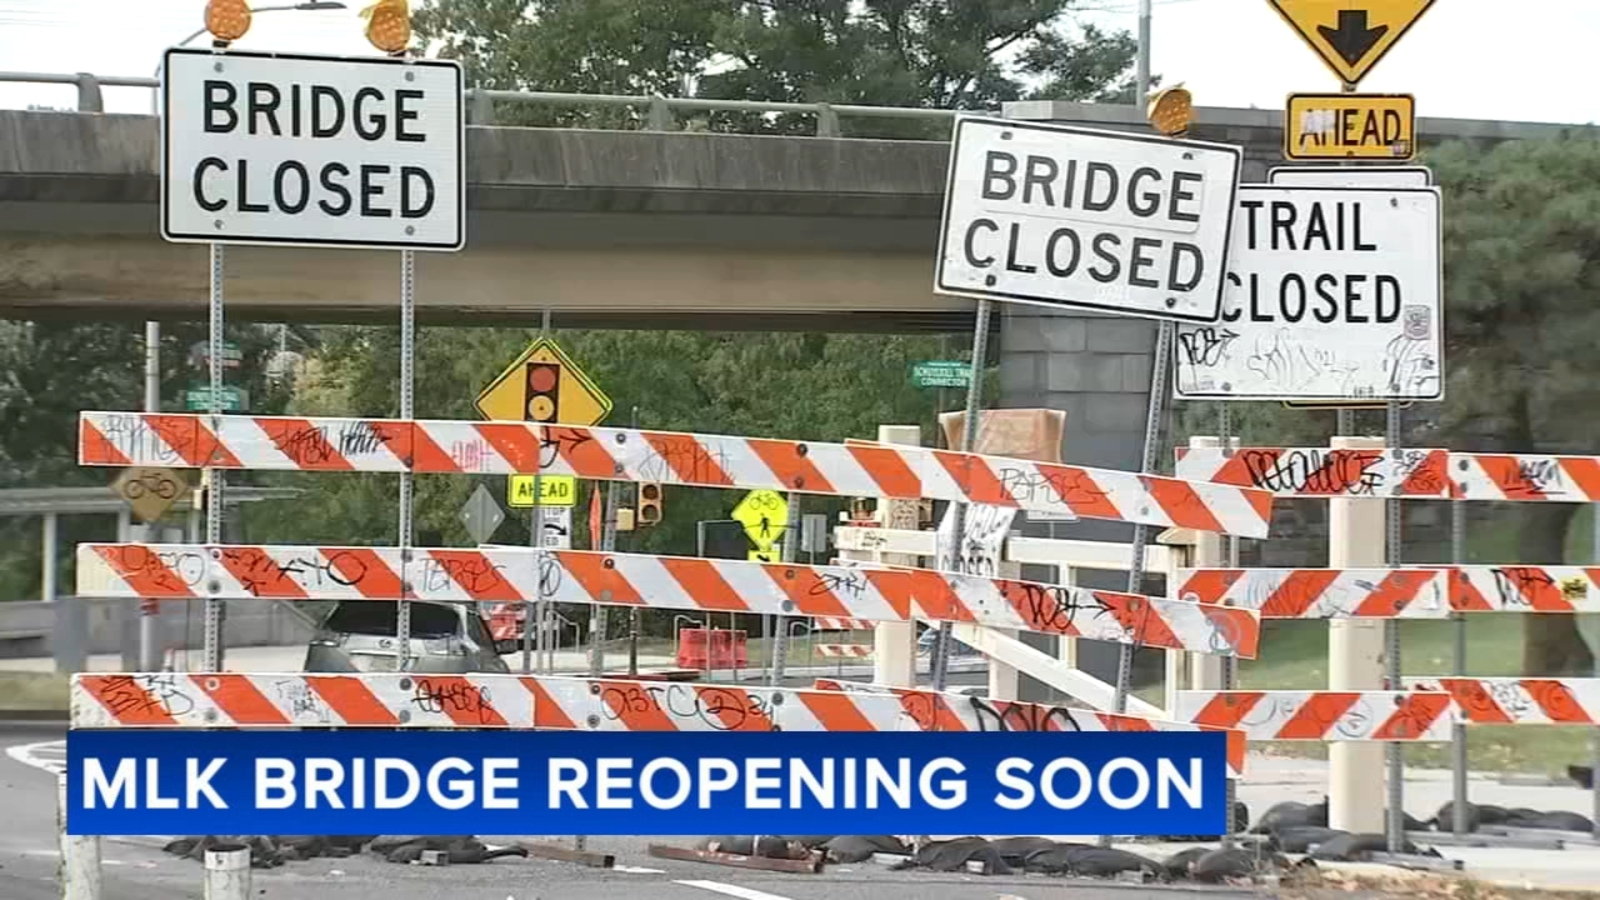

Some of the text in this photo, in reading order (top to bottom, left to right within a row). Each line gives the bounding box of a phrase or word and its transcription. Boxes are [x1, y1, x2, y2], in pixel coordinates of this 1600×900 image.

[203, 79, 426, 142] BRIDGE
[193, 156, 435, 218] CLOSED
[981, 150, 1203, 223] BRIDGE
[964, 218, 1204, 292] CLOSED
[1240, 200, 1377, 251] TRAIL
